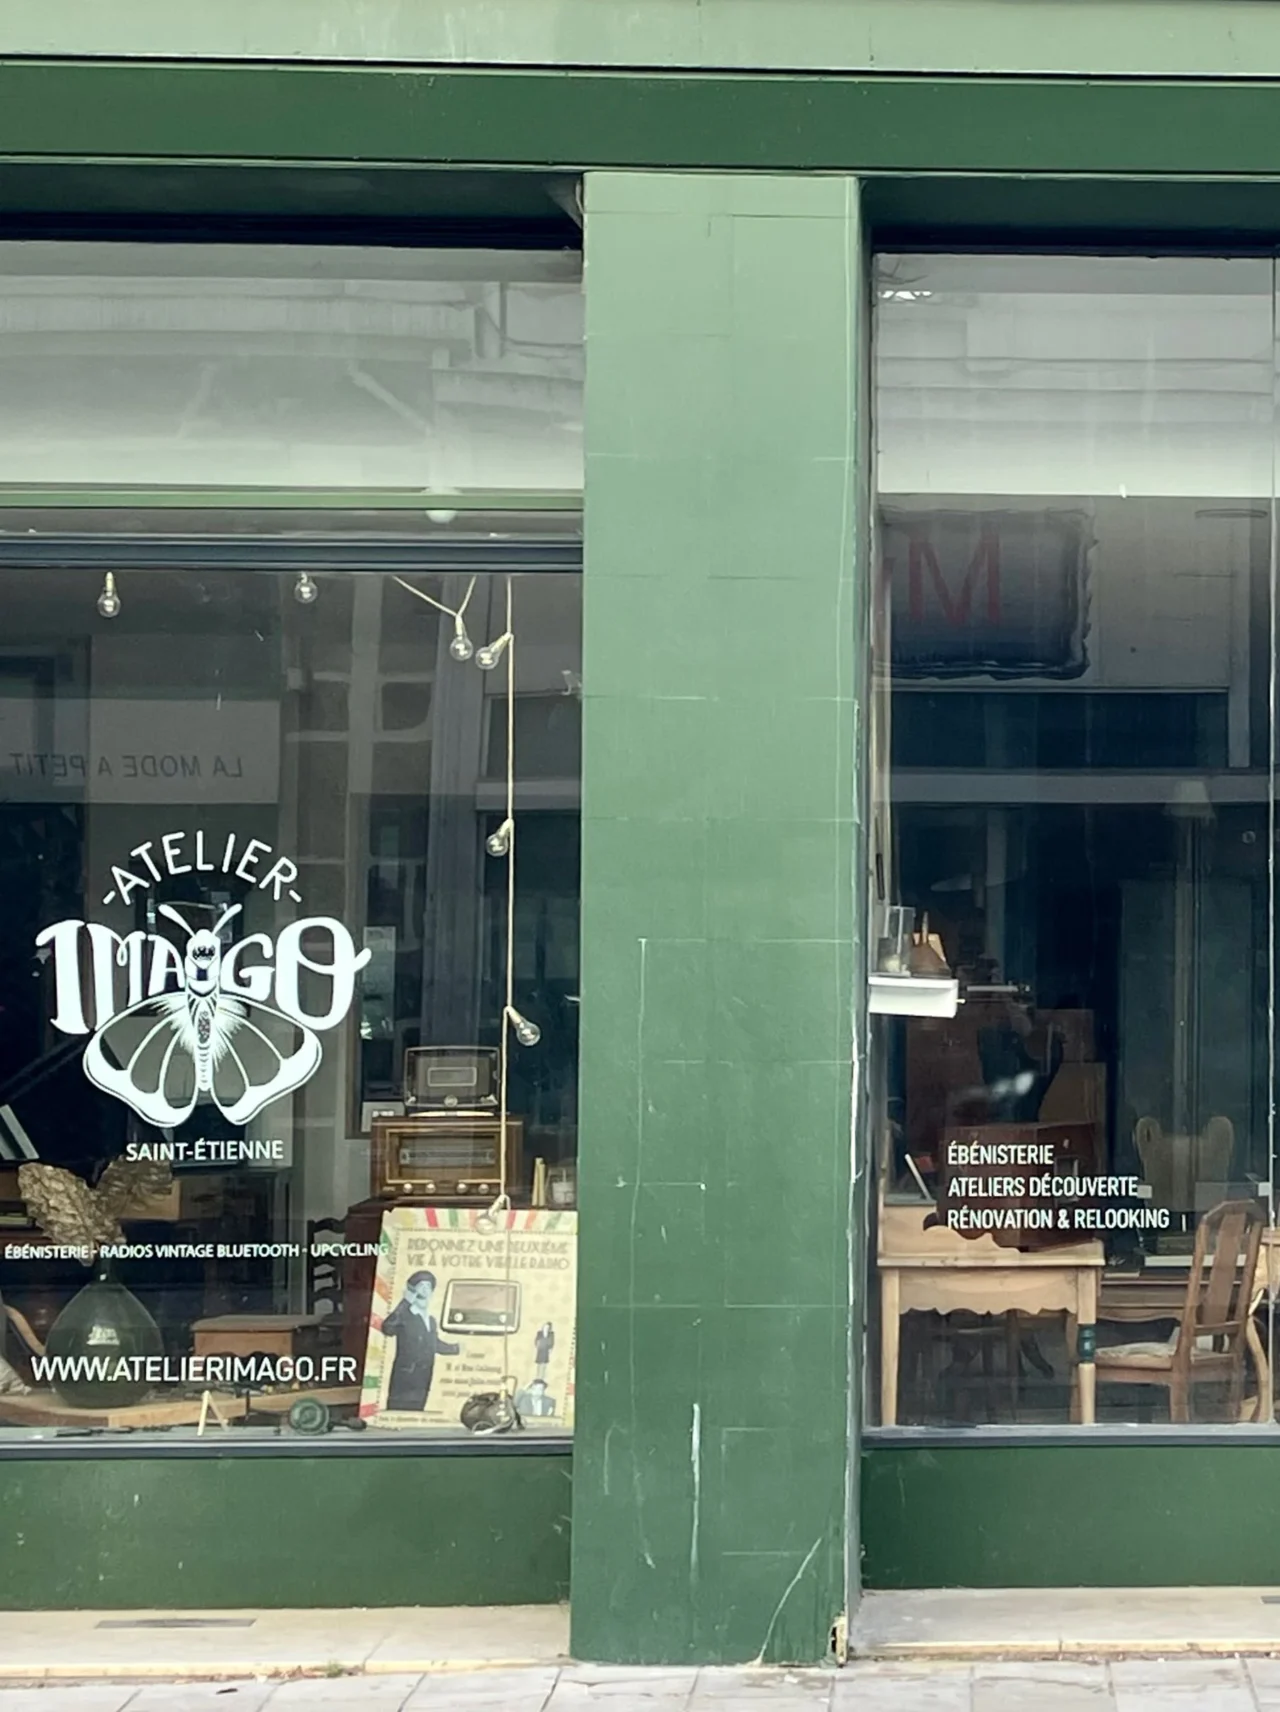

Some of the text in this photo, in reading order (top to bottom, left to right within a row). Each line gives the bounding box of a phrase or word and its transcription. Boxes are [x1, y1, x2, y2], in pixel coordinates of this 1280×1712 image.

[35, 916, 372, 1034] IMAGO
[126, 1138, 284, 1161] SAINT-ÉTIENNE
[947, 1141, 1055, 1165] ÉBÉNISTERIE
[948, 1172, 1139, 1199] ATELIERS DÉCOUVERTE
[947, 1205, 1170, 1230] RÉNOVATION & RELOOKING
[4, 1243, 90, 1260] ÉBÉNISTERIE
[100, 1244, 154, 1260] RADIOS
[155, 1244, 214, 1259] VINTAGE
[216, 1243, 300, 1258] BLUETOOTH
[310, 1242, 389, 1257] UPCYCLING
[31, 1356, 357, 1382] WWW.ATELIERIMAGO.FR
